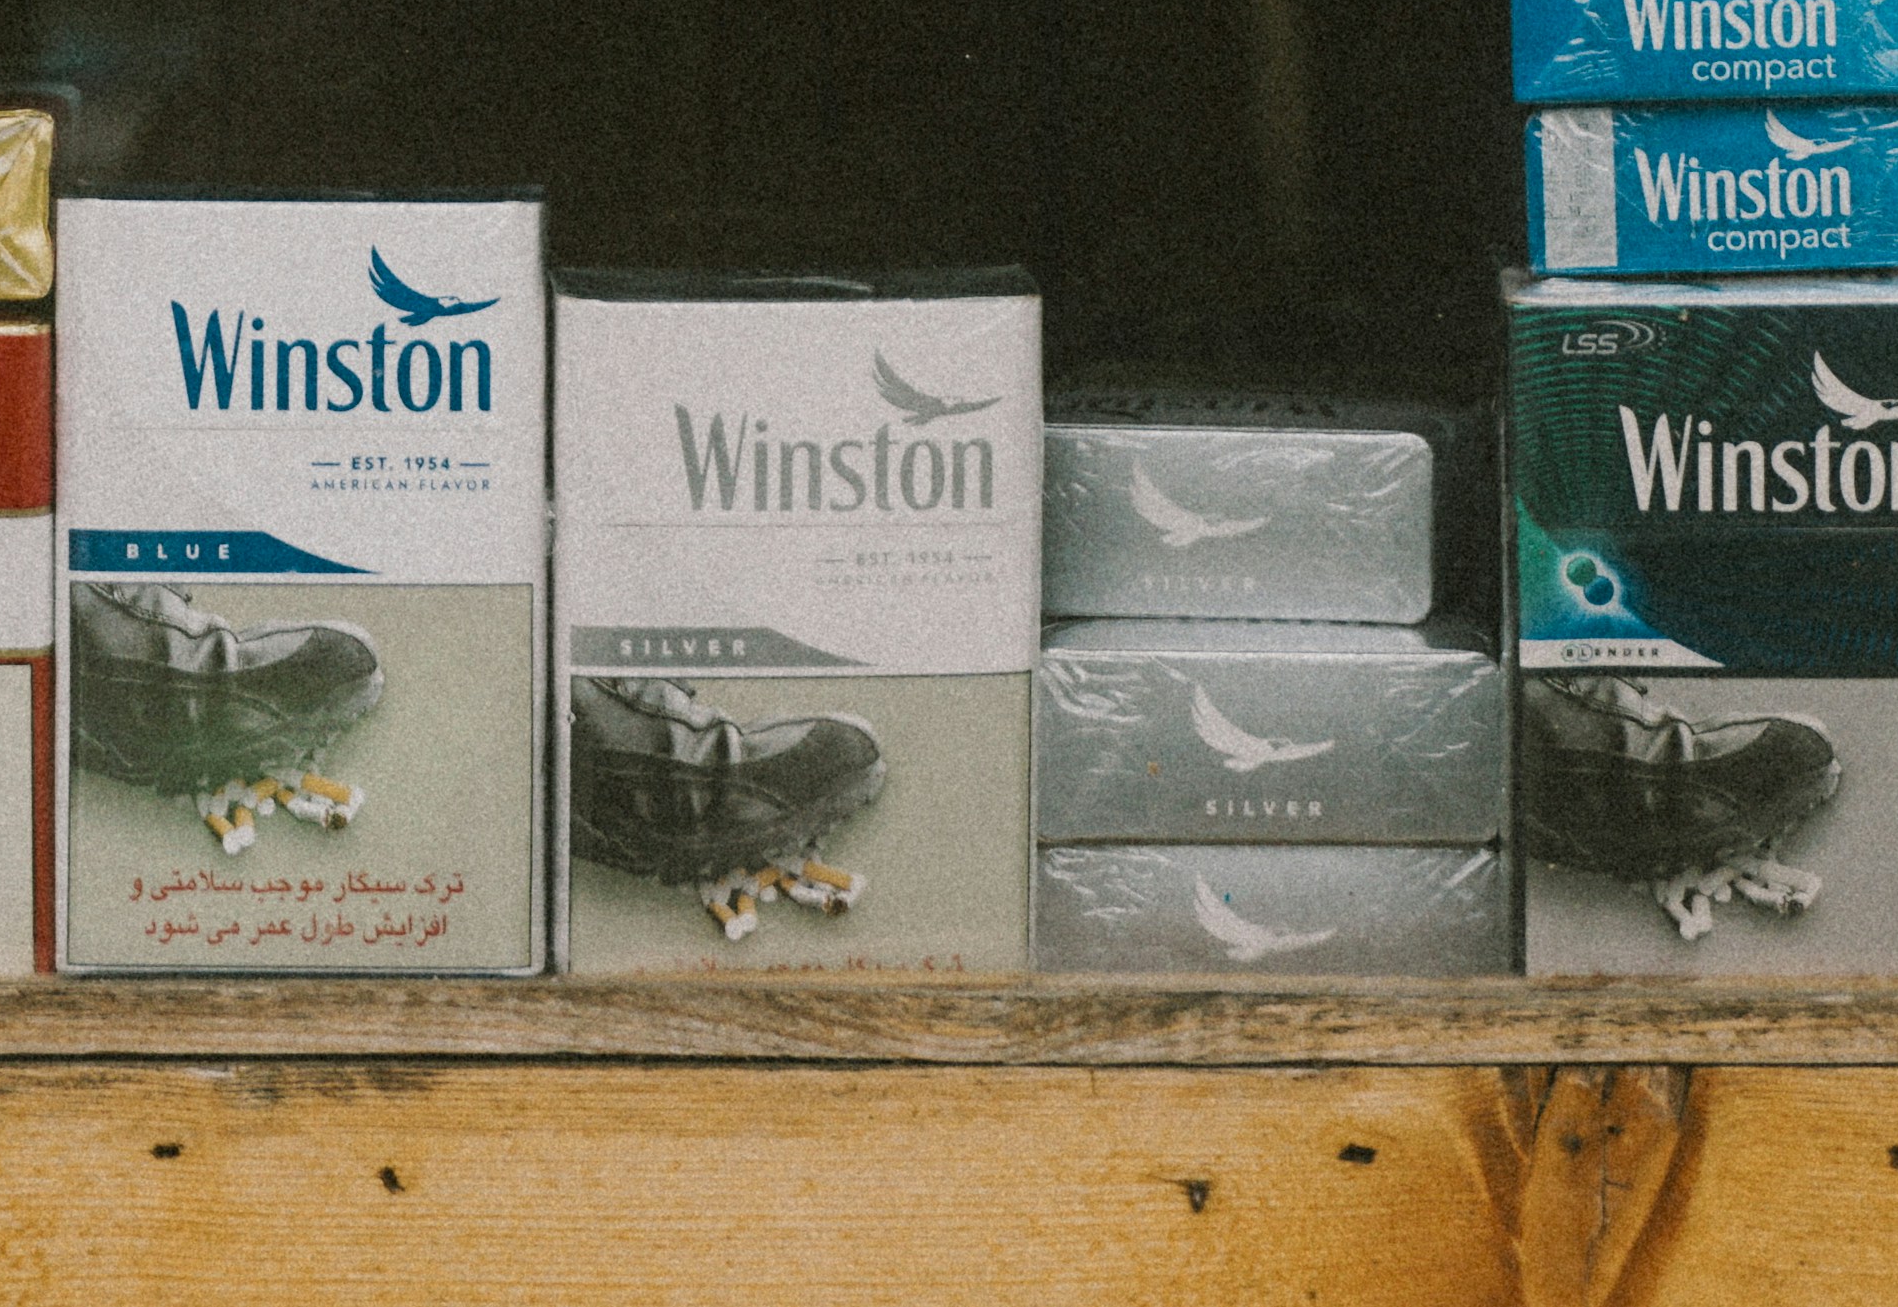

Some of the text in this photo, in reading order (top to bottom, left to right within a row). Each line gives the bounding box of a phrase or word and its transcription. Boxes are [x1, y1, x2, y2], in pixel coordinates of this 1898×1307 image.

[1691, 54, 1837, 86] compact
[1634, 148, 1852, 223] Winston
[1707, 224, 1852, 255] compact
[170, 301, 491, 414] Winston
[1562, 332, 1618, 354] LSS
[350, 455, 451, 471] EST. 1954
[675, 404, 994, 513] Winston
[310, 477, 491, 491] AMERICAN FLAVOR
[126, 543, 231, 560] BLUE
[621, 638, 747, 657] SILVER
[1206, 799, 1323, 817] SILVER
[130, 872, 464, 904] ترک سیگار موجب سلامتی و
[147, 913, 447, 945] افزایش طول عمر می شود
